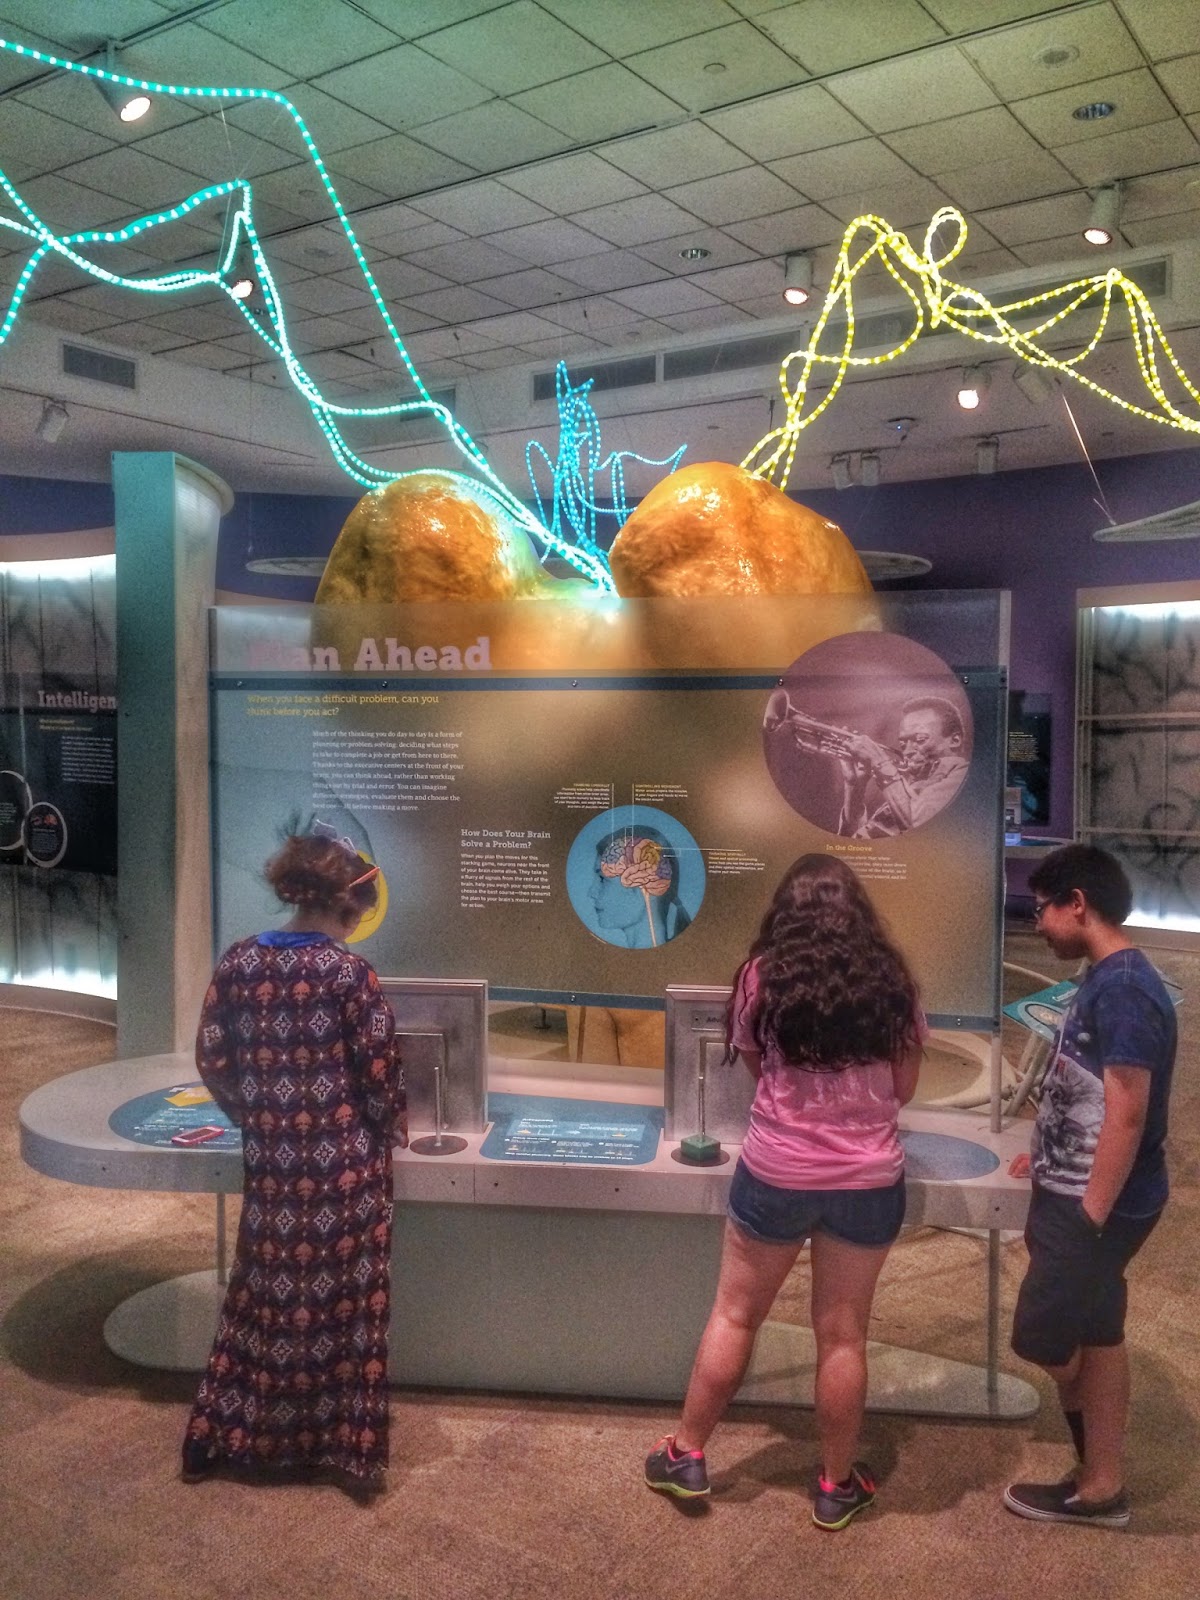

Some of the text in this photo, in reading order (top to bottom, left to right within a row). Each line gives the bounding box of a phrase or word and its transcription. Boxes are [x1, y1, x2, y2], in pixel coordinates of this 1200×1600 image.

[354, 636, 492, 672] Ahead
[275, 696, 292, 705] you
[360, 695, 399, 705] problem,
[422, 696, 439, 705] you
[303, 709, 320, 717] you
